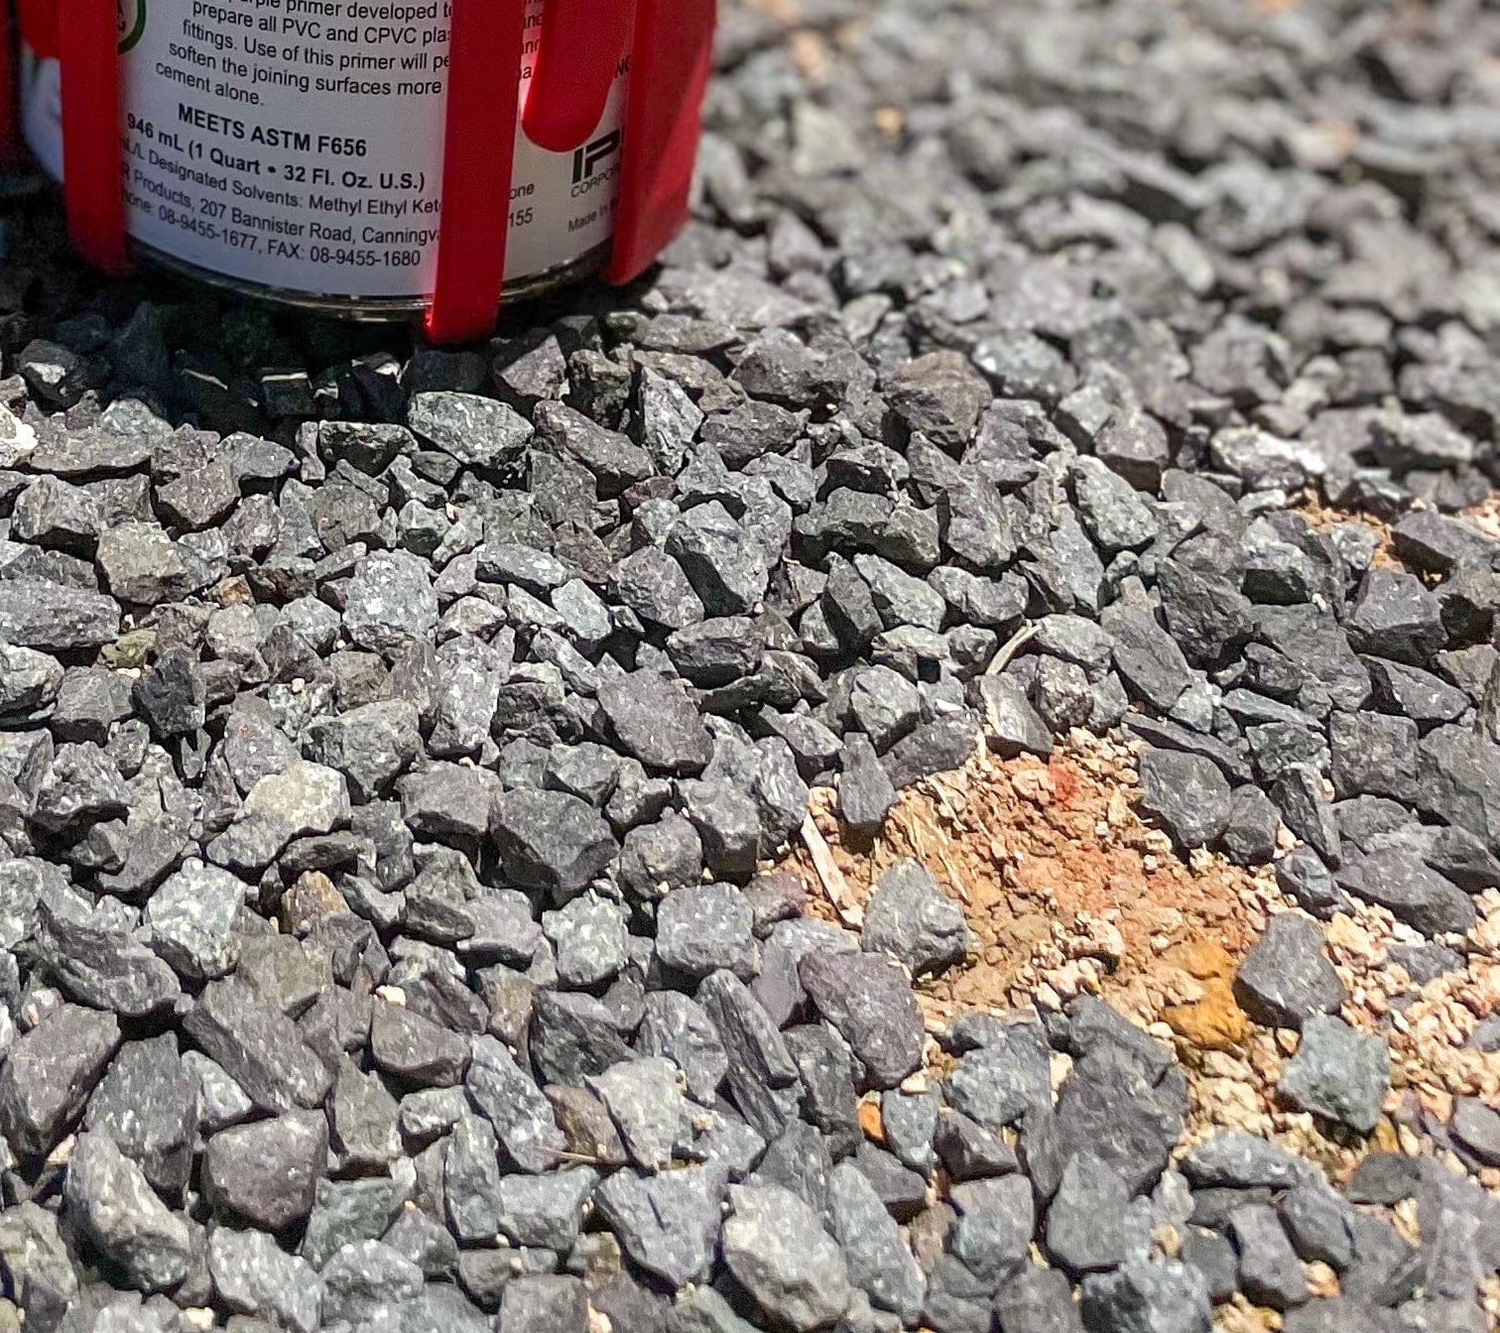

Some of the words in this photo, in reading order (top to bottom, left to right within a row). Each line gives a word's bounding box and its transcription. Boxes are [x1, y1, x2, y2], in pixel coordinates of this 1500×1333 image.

[192, 0, 253, 28] prepare
[258, 13, 277, 33] all
[282, 18, 321, 39] PVC
[325, 25, 358, 42] and
[363, 26, 417, 44] CPVC
[346, 1, 438, 24] developed
[168, 41, 216, 70] soften
[221, 57, 248, 78] the
[251, 66, 310, 93] joining
[315, 75, 391, 96] surfaces
[396, 80, 442, 96] more
[182, 18, 238, 51] fittings.
[243, 35, 278, 58] Use
[281, 45, 300, 62] of
[303, 47, 334, 67] this
[339, 52, 396, 72] primer
[400, 52, 428, 70] will
[155, 61, 211, 92] cement
[215, 81, 264, 107] alone.
[126, 112, 154, 139] 946
[158, 130, 185, 153] mL
[188, 139, 203, 160] (1
[209, 147, 261, 175] Quart
[283, 164, 306, 183] 32
[311, 167, 335, 186] Fl.
[341, 171, 373, 189] Oz.
[379, 172, 426, 193] U.S.)
[177, 102, 245, 140] MEETS
[250, 125, 311, 152] ASTM
[317, 134, 367, 157] F656
[133, 168, 196, 213] Products,
[200, 197, 227, 220] 207
[231, 207, 306, 237] Bannister
[309, 222, 356, 245] Road,
[148, 148, 227, 191] Designated
[231, 180, 303, 208] Solvents:
[308, 193, 362, 216] Methyl
[367, 198, 407, 218] Ethyl
[412, 198, 441, 214] Ket
[267, 238, 305, 260] FAX:
[309, 245, 421, 267] 08-9455-1680
